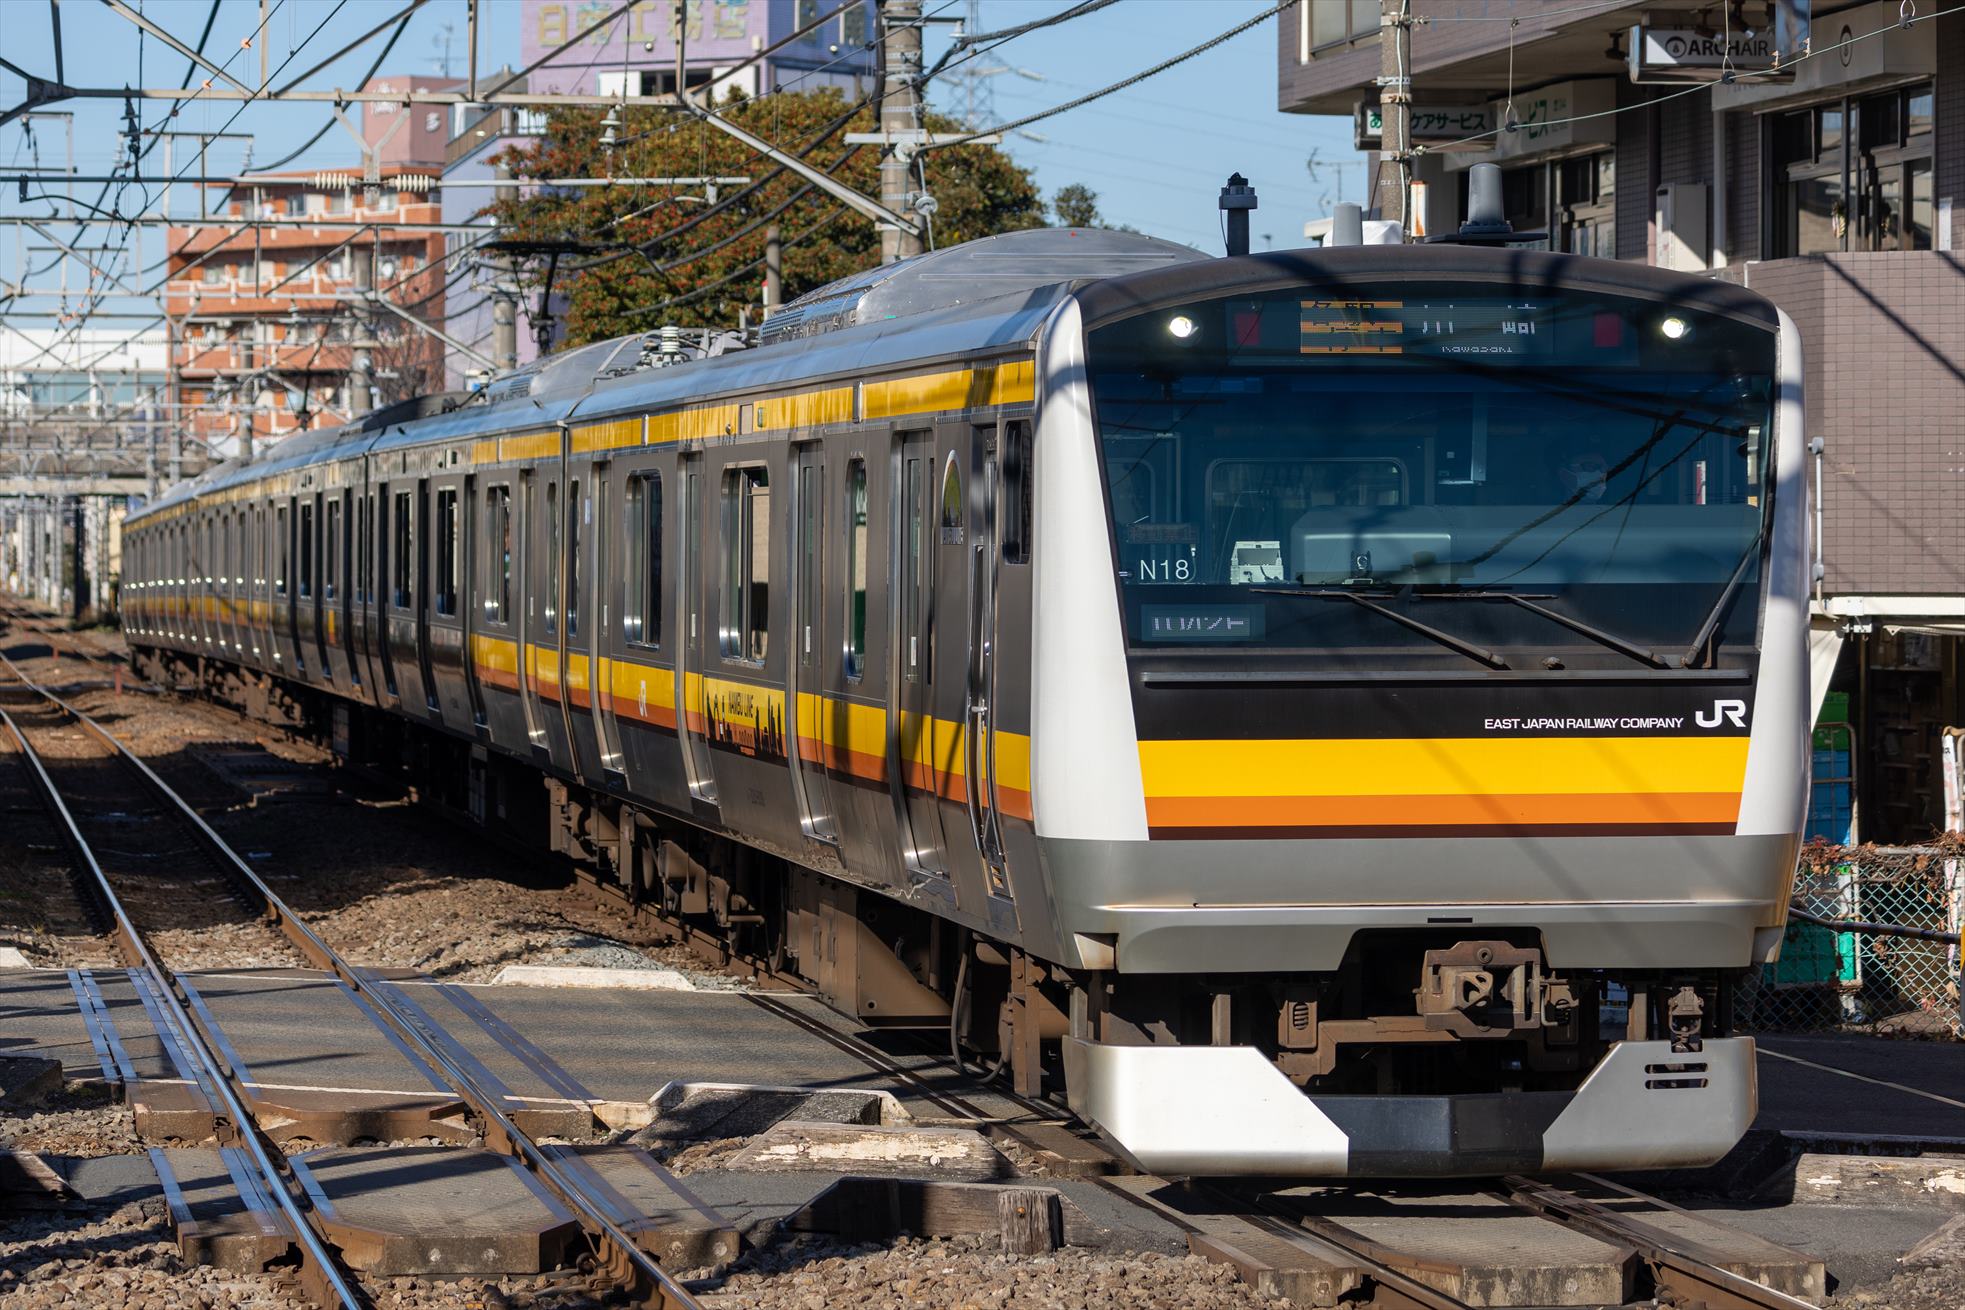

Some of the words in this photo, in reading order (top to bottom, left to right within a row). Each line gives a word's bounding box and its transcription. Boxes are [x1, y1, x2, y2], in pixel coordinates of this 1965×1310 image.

[1140, 559, 1190, 580] N18
[1484, 718, 1520, 729] EAST
[1521, 718, 1565, 729] JAPAN
[1566, 718, 1619, 729] RAILWAY
[1620, 717, 1684, 729] COMPANY
[1695, 699, 1746, 728] JR
